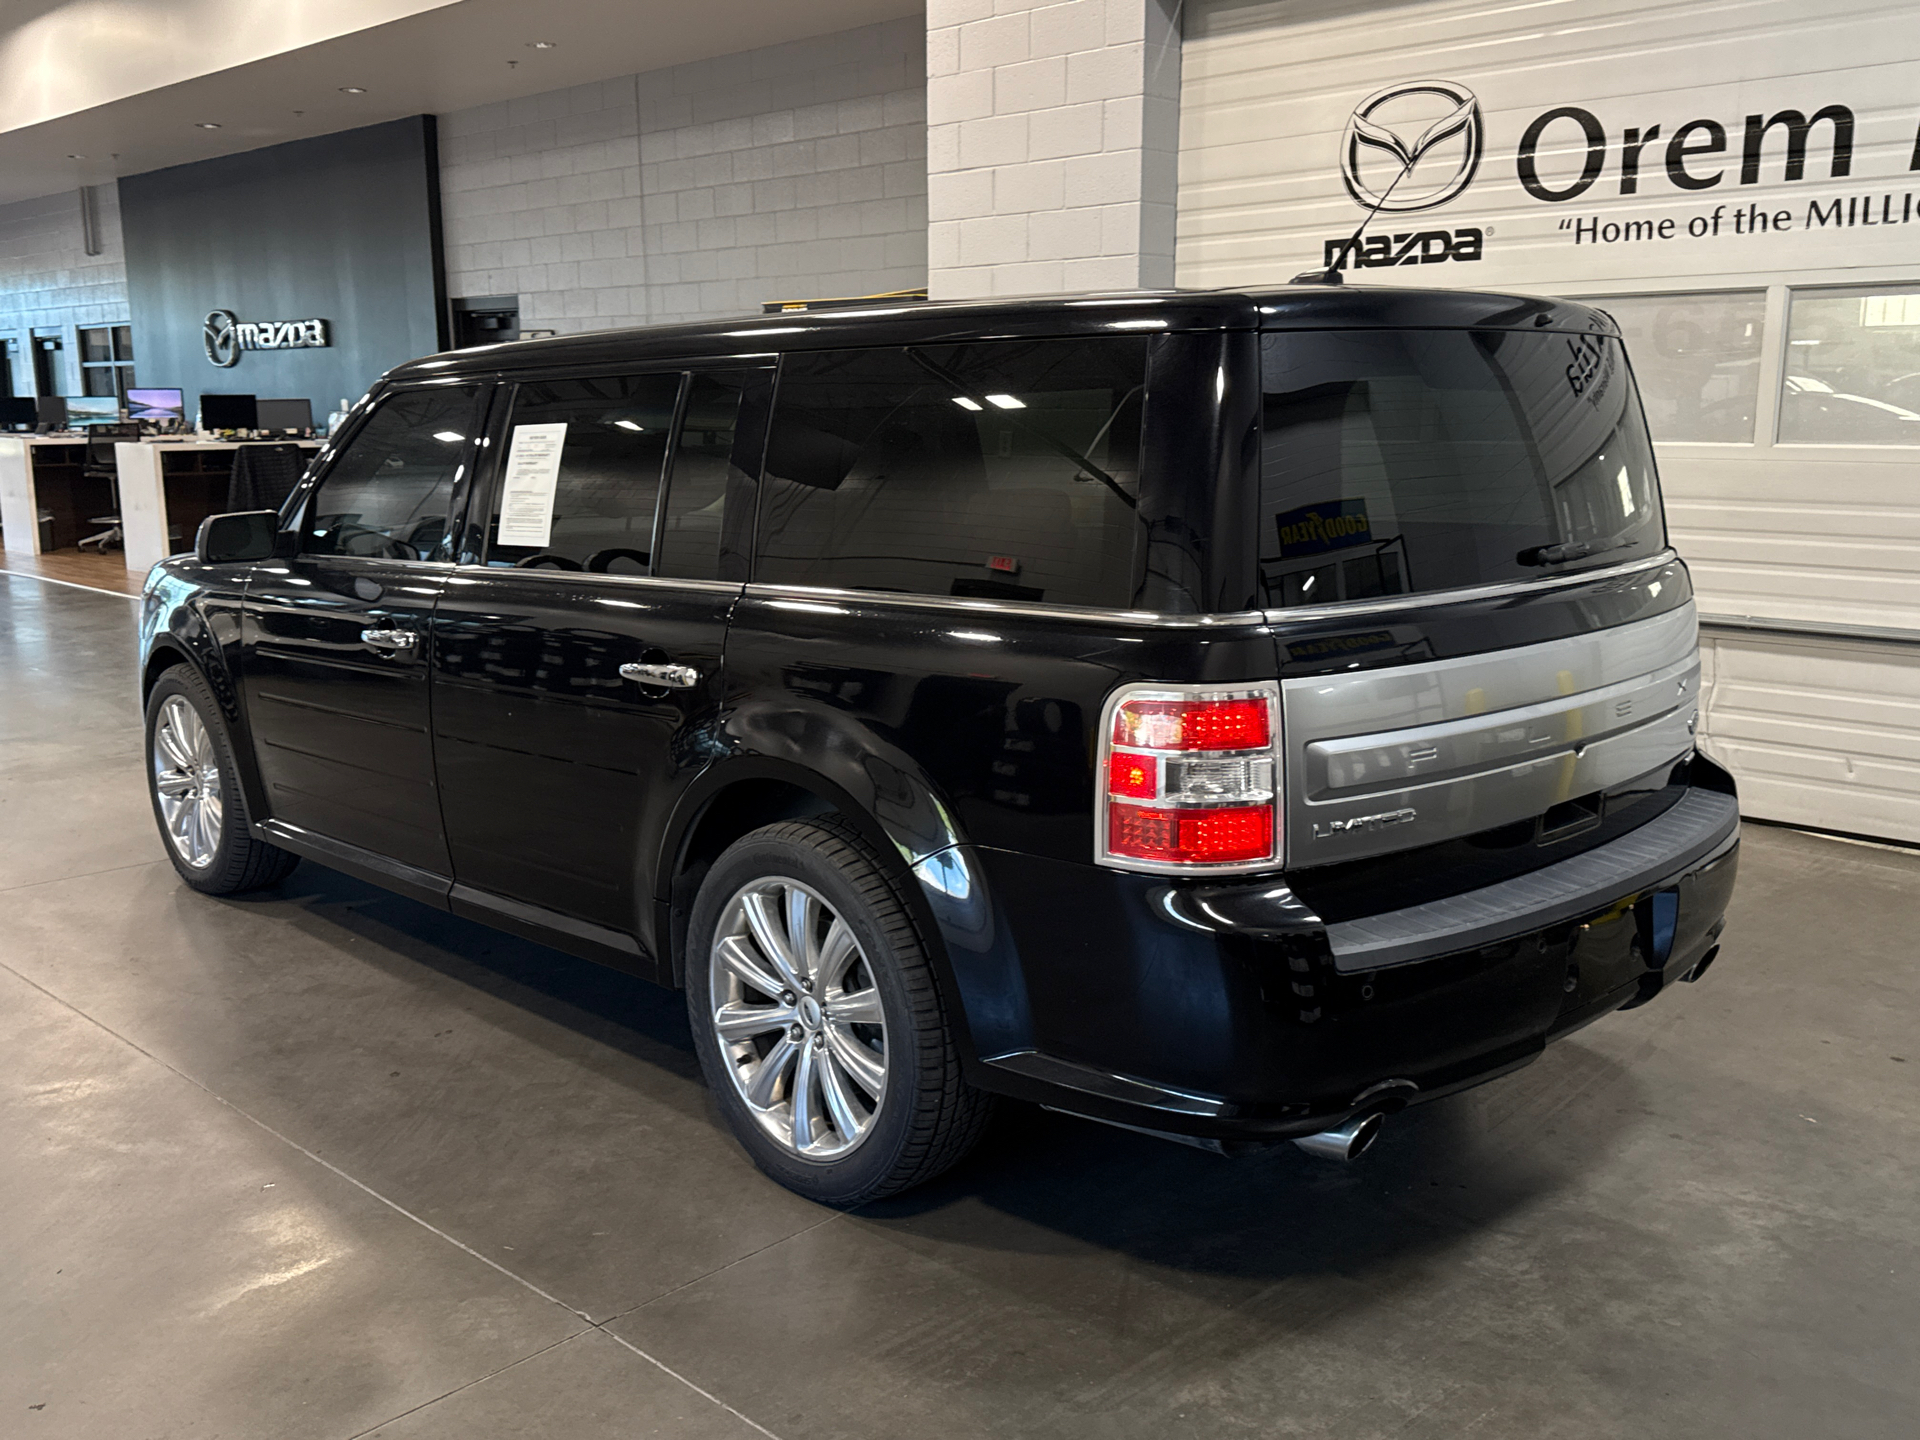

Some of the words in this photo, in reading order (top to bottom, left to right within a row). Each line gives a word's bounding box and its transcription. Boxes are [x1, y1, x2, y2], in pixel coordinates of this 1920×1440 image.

[1516, 104, 1855, 202] Orem
[1558, 216, 1676, 244] “Home
[1688, 205, 1727, 237] of
[1733, 203, 1793, 234] the
[1805, 193, 1920, 230] MILLI
[1324, 228, 1483, 270] mazda
[236, 318, 327, 350] mazda
[1313, 807, 1417, 840] LIMITED
